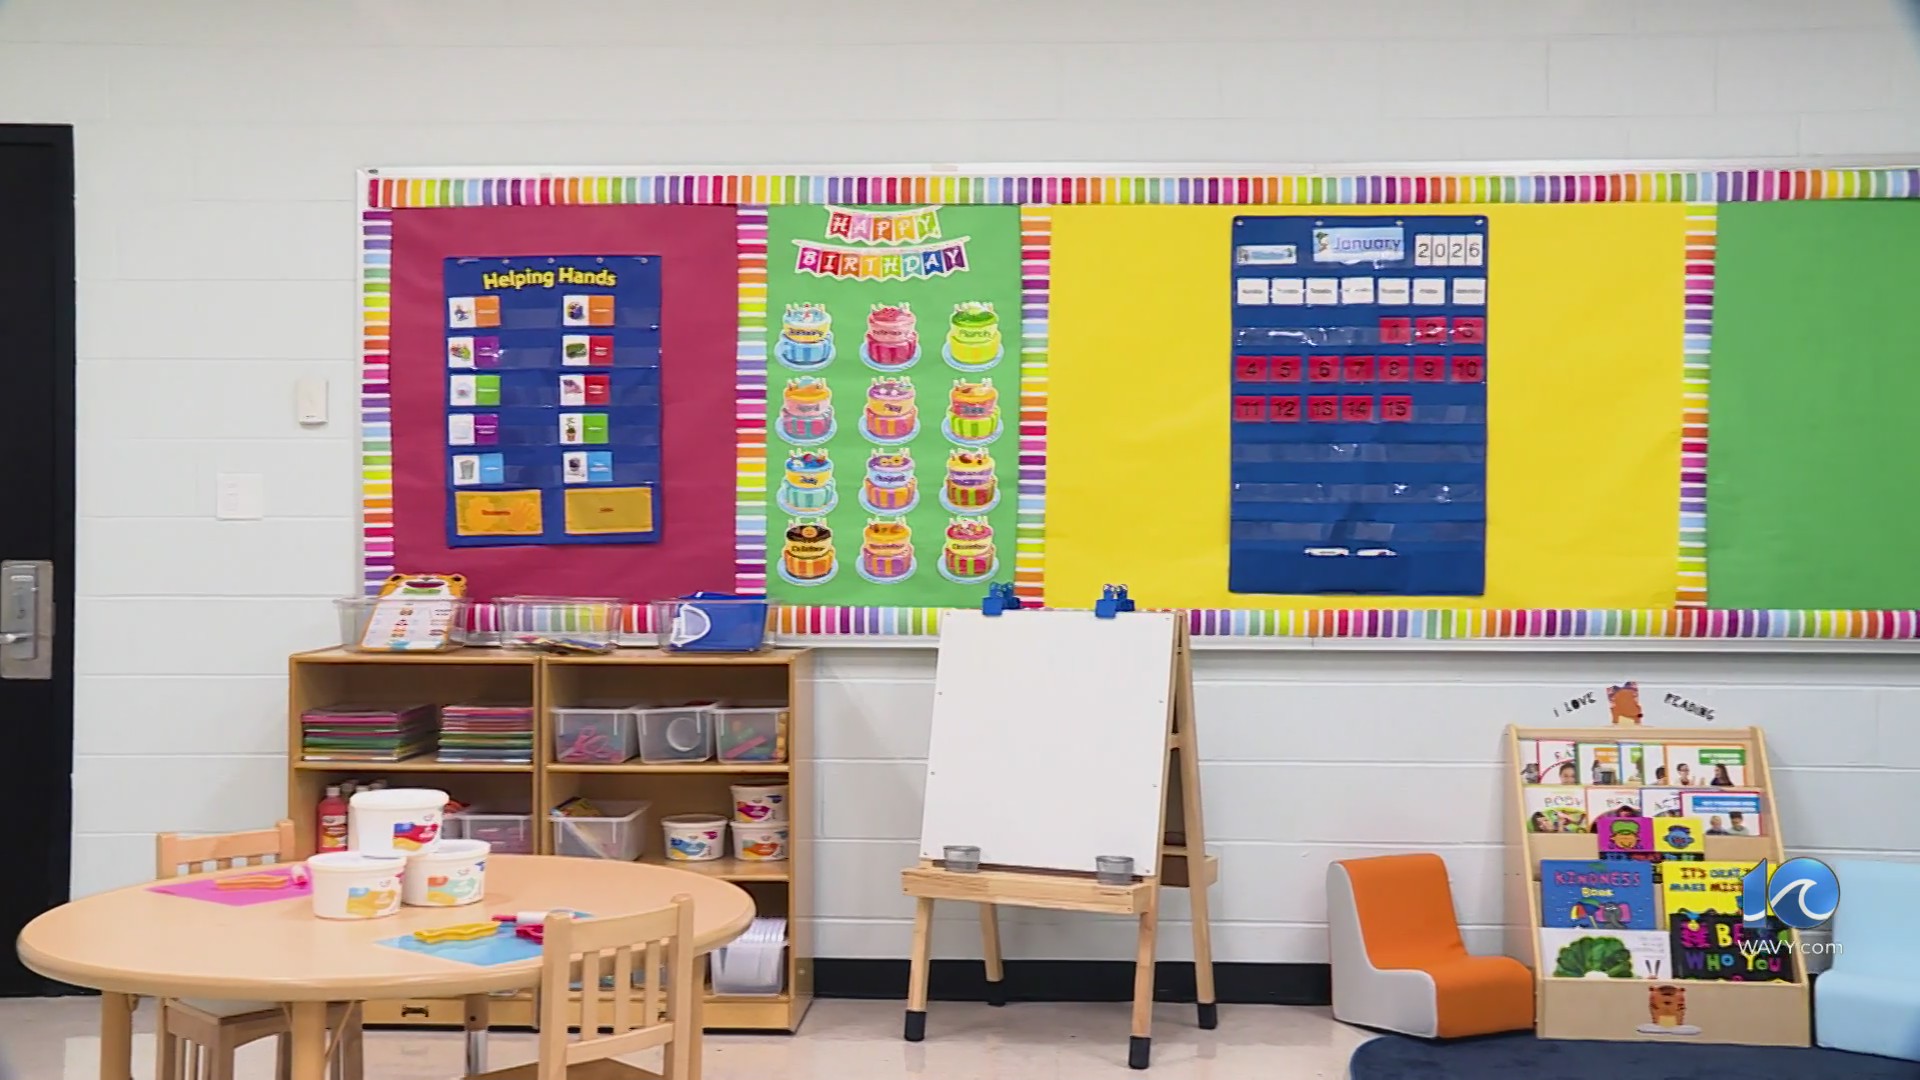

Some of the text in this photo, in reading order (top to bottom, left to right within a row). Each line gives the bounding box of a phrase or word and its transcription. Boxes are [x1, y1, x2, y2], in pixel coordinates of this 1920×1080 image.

[833, 213, 937, 237] HAPPY
[1333, 237, 1401, 252] January
[802, 249, 961, 273] BIRTHDAY
[482, 267, 617, 290] Helping Hands
[1245, 361, 1477, 378] 4 5 6 7 8 9 10
[1241, 401, 1406, 416] 11 12 13 14 15
[1563, 691, 1597, 713] LOVE
[1554, 870, 1641, 888] KINDNESS
